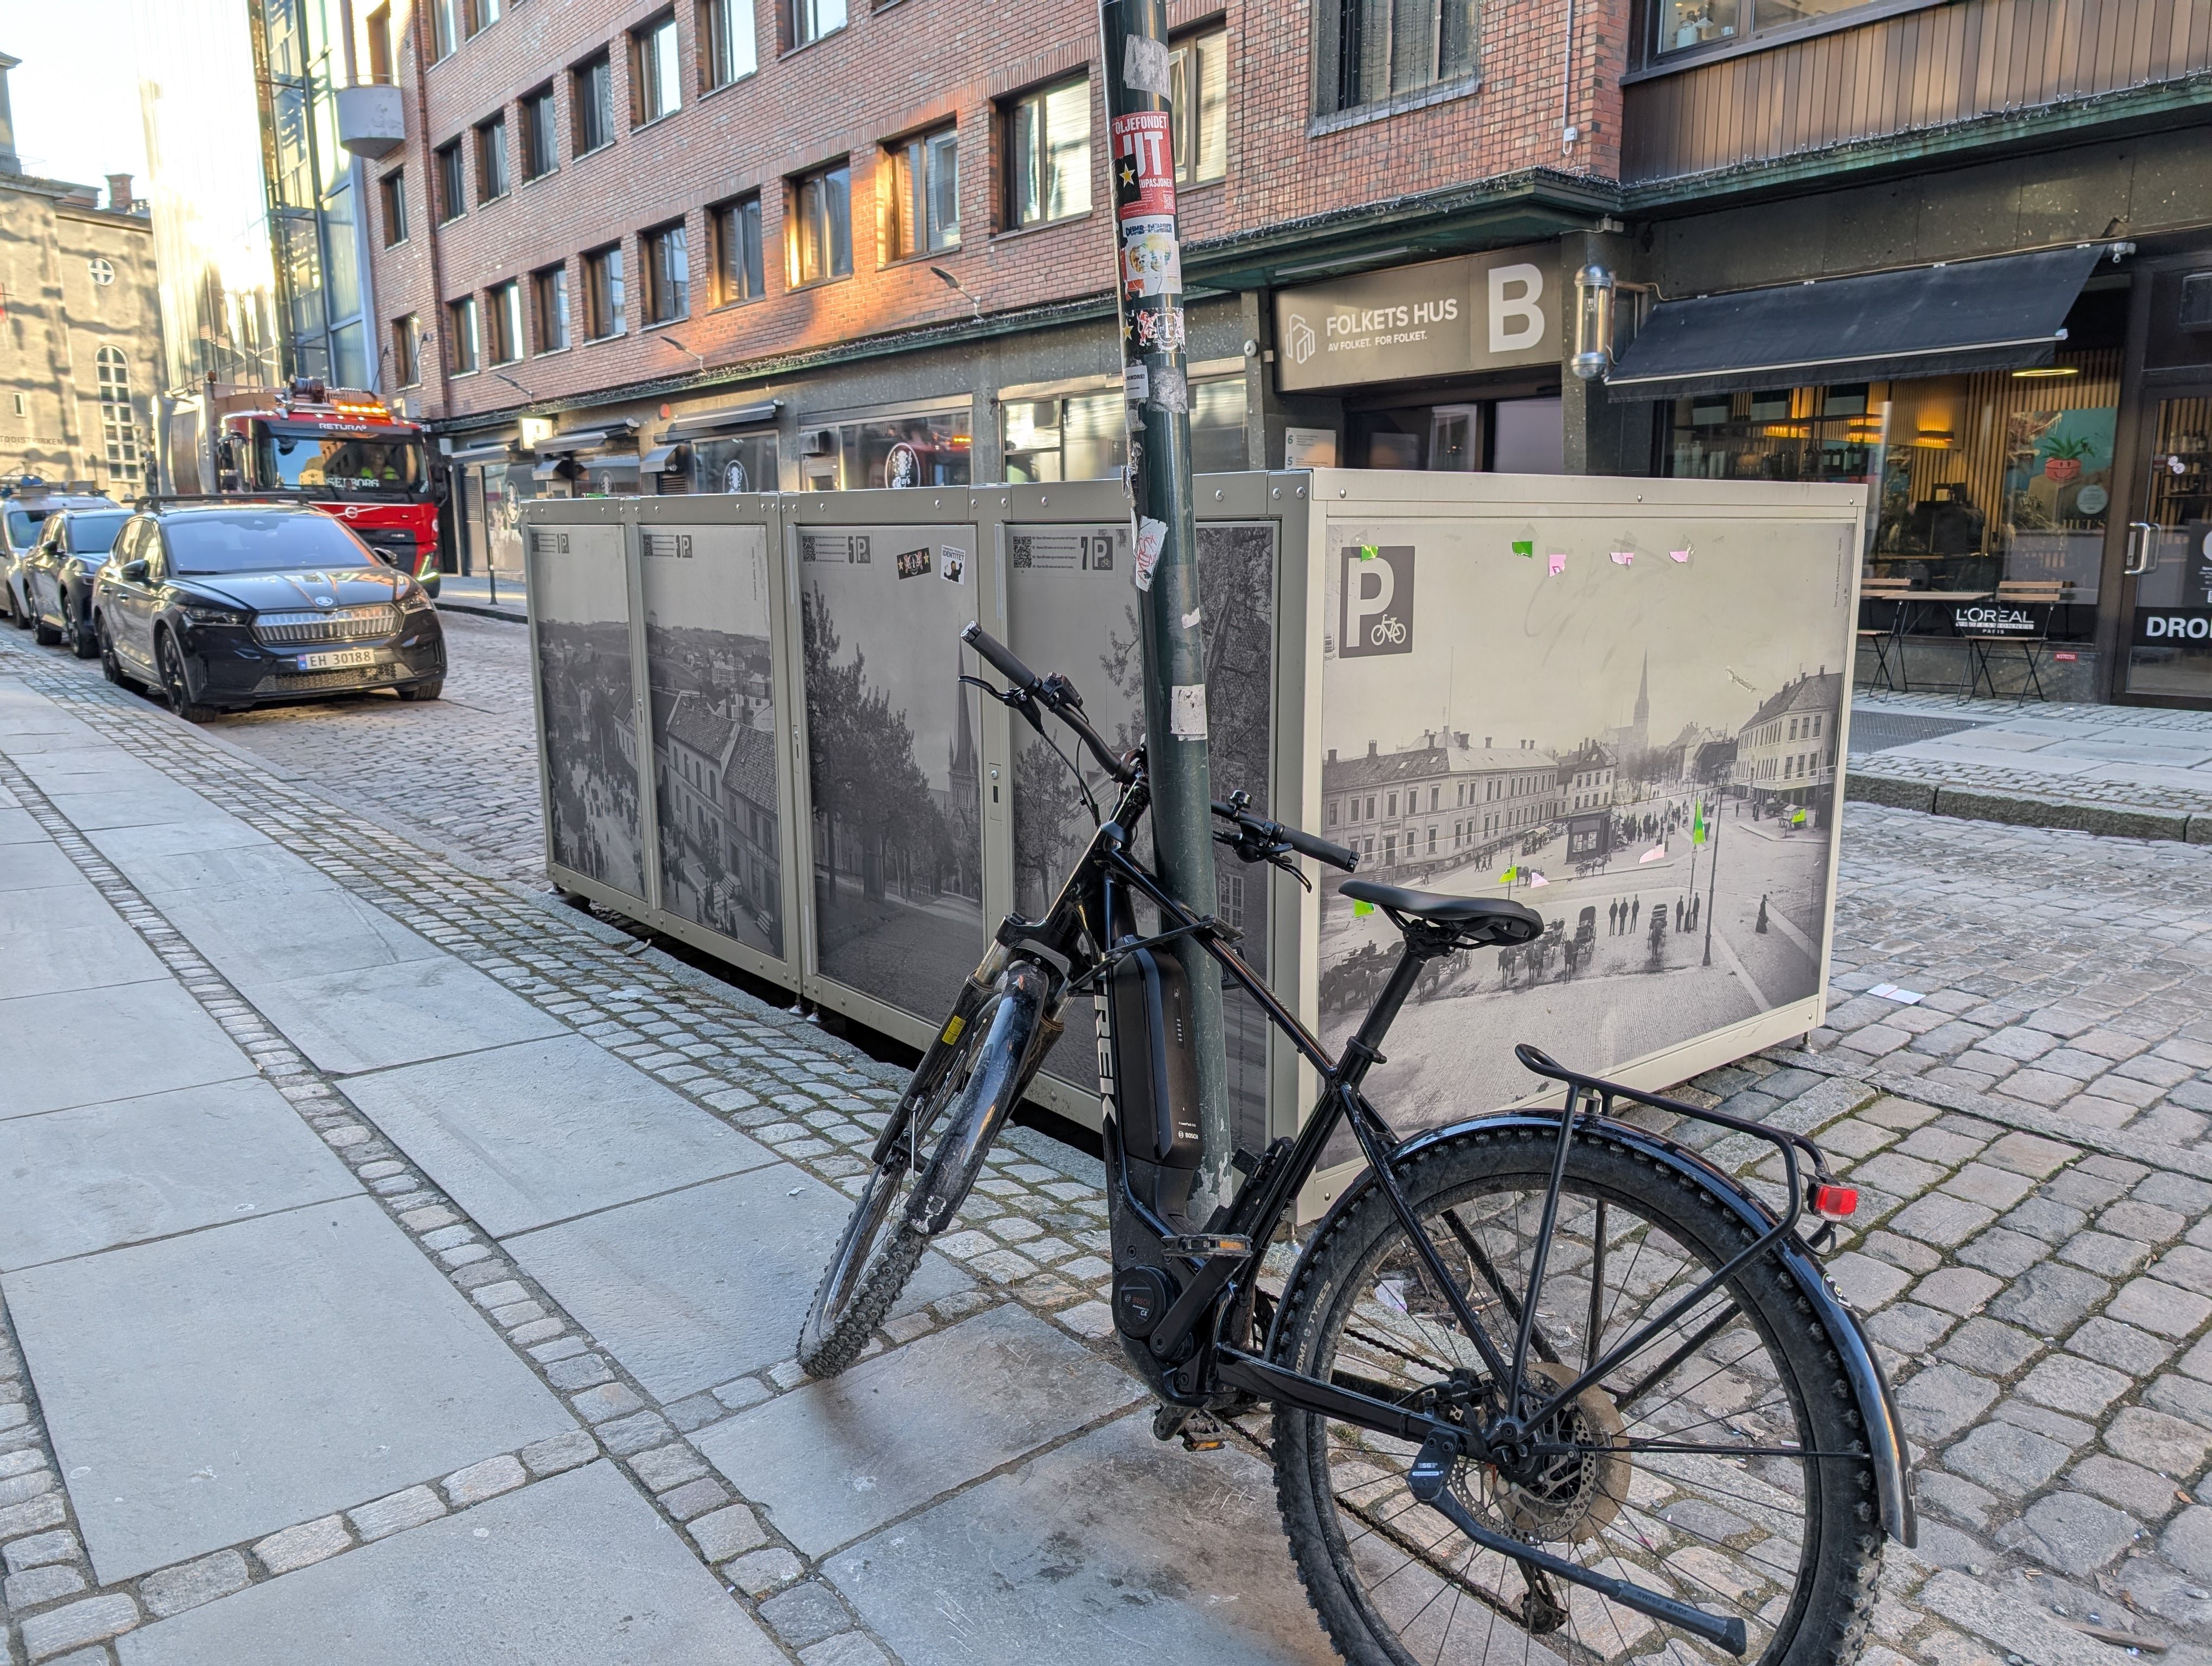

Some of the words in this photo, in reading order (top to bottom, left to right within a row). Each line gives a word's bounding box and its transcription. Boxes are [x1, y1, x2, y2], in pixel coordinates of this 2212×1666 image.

[1115, 116, 1167, 135] OLJEFONDET
[1123, 131, 1163, 178] UT
[1326, 305, 1409, 337] FOLKETS
[1413, 298, 1459, 325] HUS
[1488, 262, 1546, 354] B
[1328, 343, 1339, 352] AV
[1340, 337, 1372, 351] FOLKET.
[1375, 334, 1392, 346] FOR
[1393, 330, 1427, 344] FOLKET.
[319, 422, 364, 431] RETURA
[1287, 435, 1293, 445] 6
[1287, 456, 1293, 466] 5
[848, 536, 854, 564] 5
[942, 550, 965, 561] IDENTITET
[1081, 536, 1088, 570] 7
[1094, 539, 1108, 568] P
[1346, 557, 1394, 648] P
[2146, 616, 2212, 639] DRO
[309, 655, 327, 667] EH
[333, 651, 371, 665] 30188
[1308, 1279, 1332, 1324] TYRES
[1295, 1341, 1308, 1375] OMI
[1636, 1591, 1662, 1606] SWISS
[1665, 1603, 1689, 1616] MADE
